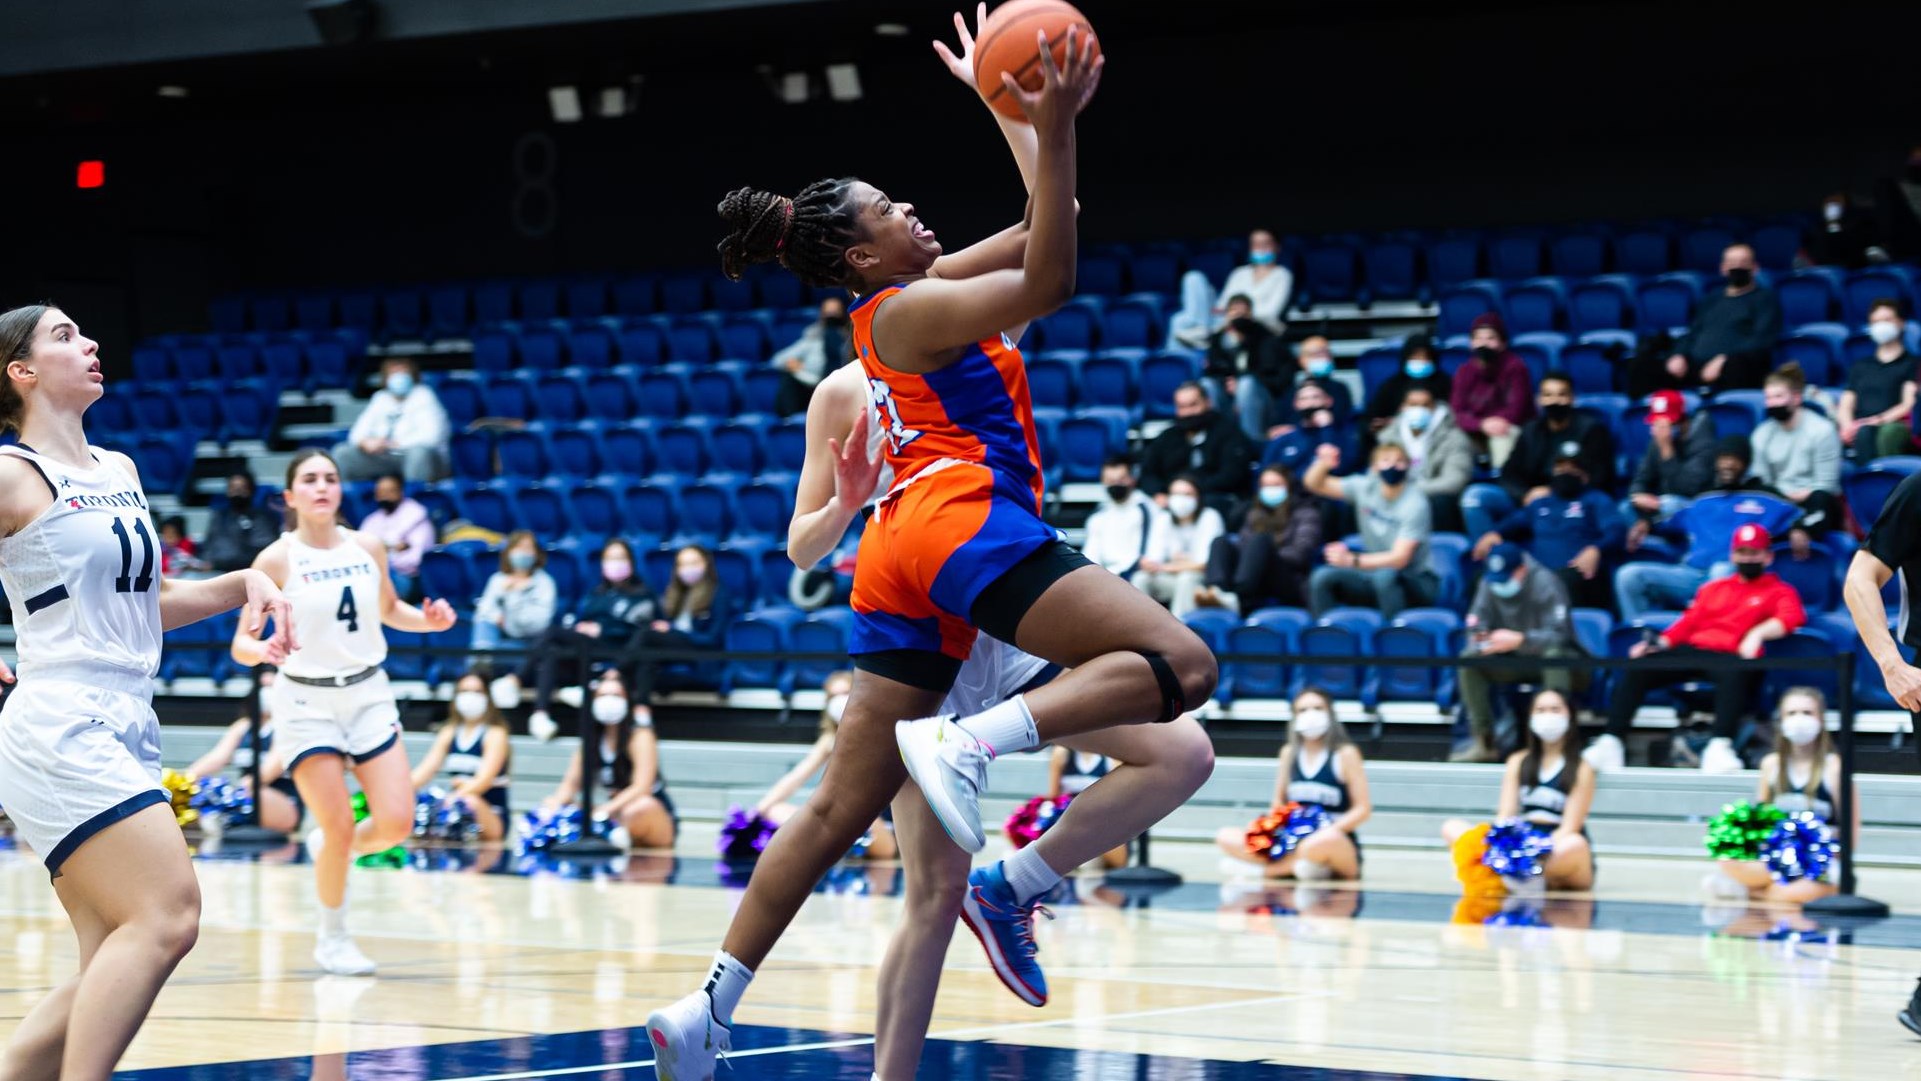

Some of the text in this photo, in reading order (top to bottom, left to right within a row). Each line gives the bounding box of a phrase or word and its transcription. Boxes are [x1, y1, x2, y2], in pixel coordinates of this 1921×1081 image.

[512, 131, 558, 239] 8
[111, 517, 154, 593] 11
[337, 585, 358, 632] 4
